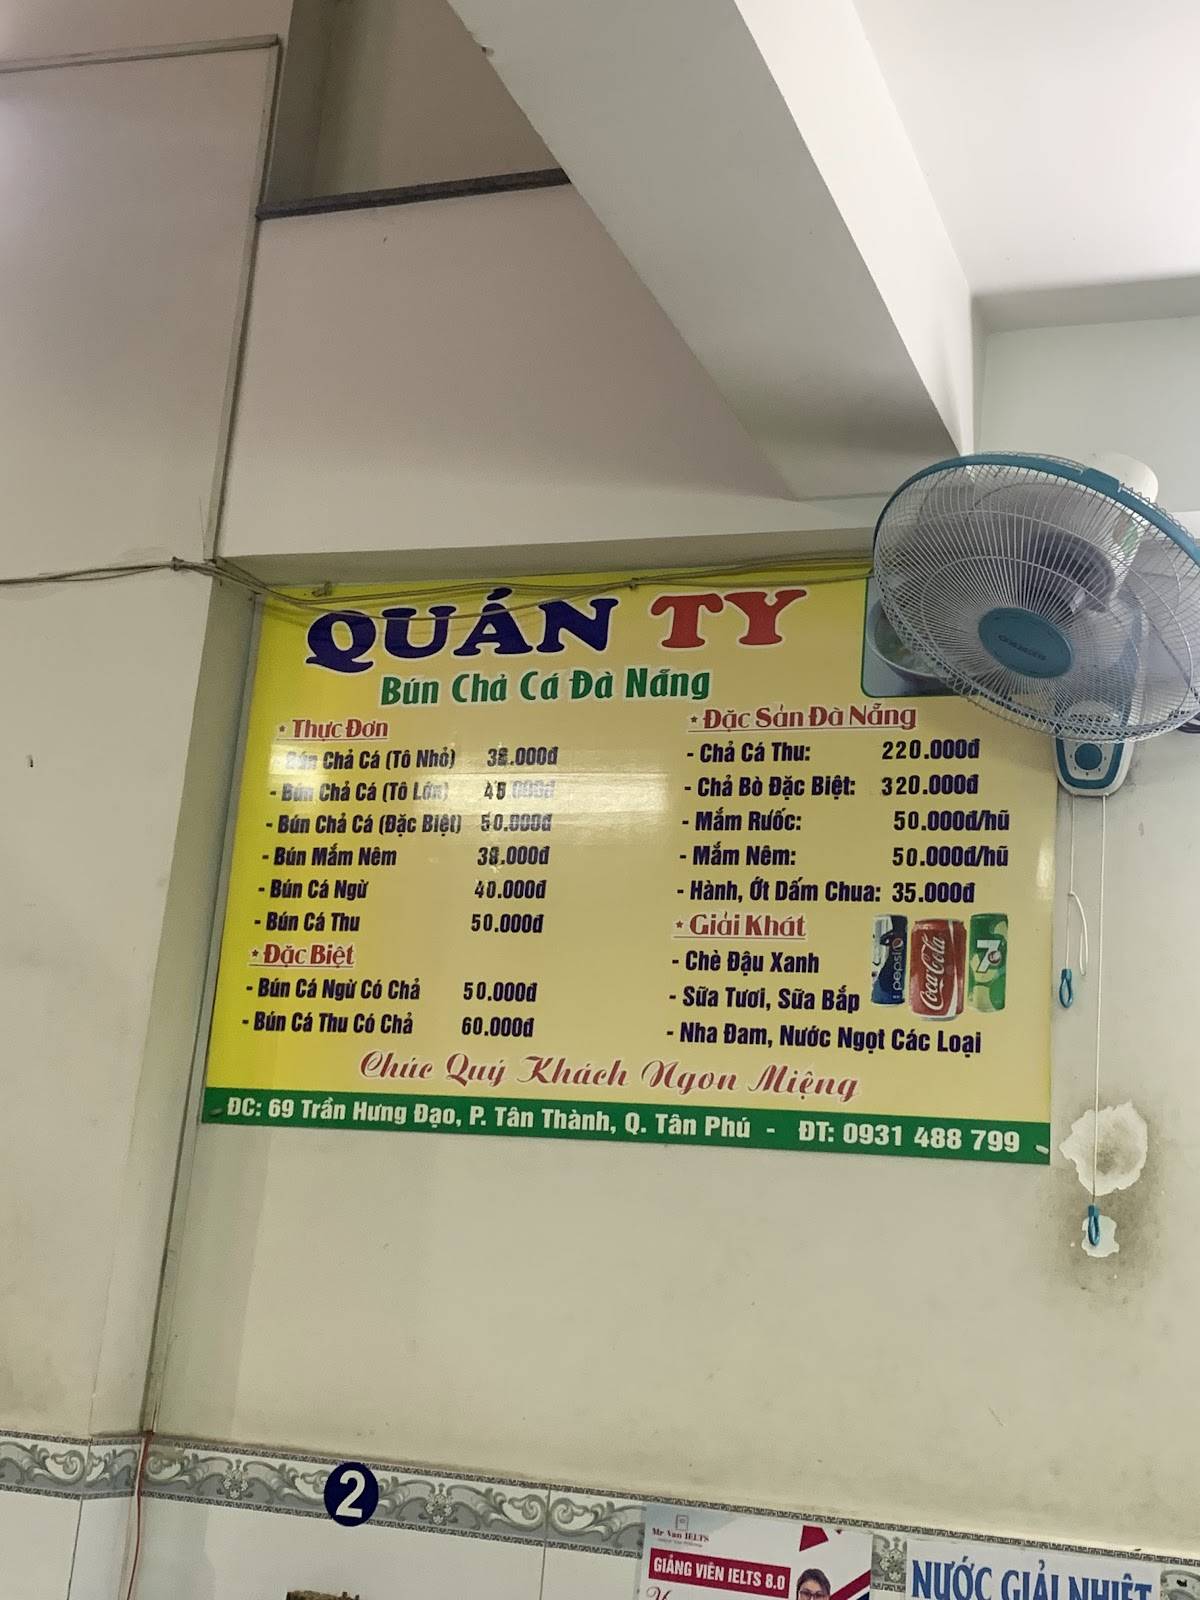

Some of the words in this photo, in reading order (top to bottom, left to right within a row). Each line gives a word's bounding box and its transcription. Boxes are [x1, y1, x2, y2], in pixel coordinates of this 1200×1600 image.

[306, 587, 619, 673] QUÁN
[651, 588, 807, 648] TY
[381, 677, 439, 705] Bún
[452, 673, 507, 702] Chả
[520, 672, 559, 700] Cá
[569, 671, 613, 700] Đà
[703, 709, 750, 732] Đặc
[755, 704, 803, 728] Sản
[808, 706, 843, 727] Đà
[849, 703, 916, 729] Nẵng
[293, 720, 343, 741] Thực
[345, 719, 388, 738] Đơn
[323, 749, 354, 769] Chả
[359, 751, 380, 769] Cá
[386, 749, 411, 770] (Tô
[416, 747, 455, 769] Nhỏ)
[699, 740, 735, 763] Chả
[740, 740, 766, 762] Cá
[771, 742, 811, 762] Thu:
[881, 738, 980, 760] 220.000đ
[282, 783, 313, 801] Bún
[319, 781, 350, 801] Chả
[356, 782, 376, 800] Cá
[383, 782, 407, 802] (Tô
[697, 775, 733, 797] Chả
[739, 775, 763, 796] Bò
[768, 776, 806, 799] Đặc
[810, 775, 856, 799] Biệt:
[880, 774, 979, 796] 320.000đ
[278, 815, 310, 833] Bún
[315, 812, 346, 833] Chả
[352, 814, 373, 833] Cá
[379, 815, 416, 836] (Đặc
[422, 814, 461, 836] Biệt)
[481, 813, 552, 831] 50.000đ
[695, 807, 743, 832] Mắm
[893, 808, 1010, 832] 50.000đ/hũ
[273, 847, 305, 866] Bún
[312, 843, 353, 866] Mắm
[358, 846, 397, 865] Nêm
[692, 842, 740, 866] Mắm
[745, 845, 797, 866] Nêm:
[891, 843, 1009, 867] 50.000đ/hũ
[270, 879, 302, 898] Bún
[308, 879, 329, 898] Cá
[334, 879, 369, 901] Ngừ
[475, 880, 547, 898] 40.000đ
[689, 880, 743, 904] Hành,
[749, 875, 771, 902] Ớt
[775, 876, 820, 902] Dấm
[825, 880, 881, 903] Chua:
[891, 881, 975, 903] 35.000đ
[266, 912, 298, 932] Bún
[304, 912, 325, 931] Cá
[331, 912, 361, 931] Thu
[471, 913, 544, 933] 50.000đ
[689, 912, 743, 936] Giải
[745, 914, 806, 937] Khát
[263, 944, 307, 968] Đặc
[310, 944, 355, 968] Biệt
[685, 950, 721, 972] Chè
[727, 951, 764, 977] Đậu
[770, 953, 819, 973] Xanh
[258, 978, 291, 999] Bún
[295, 978, 317, 999] Cá
[322, 979, 357, 1001] Ngừ
[361, 979, 384, 1000] Có
[389, 977, 420, 1000] Chả
[463, 981, 537, 1002] 50.000đ
[682, 986, 718, 1008] Sữa
[725, 988, 771, 1011] Tươi,
[778, 988, 816, 1010] Sữa
[821, 988, 860, 1014] Bắp
[253, 1012, 286, 1032] Bún
[290, 1012, 313, 1033] Cá
[318, 1013, 350, 1033] Thu
[353, 1013, 375, 1033] Có
[380, 1012, 413, 1035] Chả
[461, 1016, 534, 1038] 60.000đ
[680, 1023, 717, 1044] Nha
[723, 1023, 773, 1049] Đam,
[780, 1023, 830, 1049] Nước
[838, 1025, 884, 1056] Ngọt
[891, 1027, 930, 1052] Các
[937, 1031, 981, 1058] Loại
[360, 1051, 434, 1079] Chúc
[446, 1054, 505, 1087] Quý
[515, 1055, 627, 1087] Khách
[642, 1060, 737, 1096] Ngon
[748, 1063, 858, 1102] Miệng
[227, 1097, 262, 1118] ĐC:
[268, 1099, 294, 1118] 69
[301, 1096, 345, 1120] Trần
[352, 1103, 406, 1125] Hưng
[413, 1105, 461, 1129] Đạo,
[469, 1106, 488, 1127] P.
[495, 1106, 534, 1129] Tân
[541, 1108, 616, 1134] Thành,
[624, 1112, 646, 1134] Q.
[655, 1112, 697, 1136] Tân
[705, 1114, 750, 1139] Phú
[798, 1120, 834, 1143] ĐT:
[843, 1123, 903, 1147] 0931
[914, 1128, 961, 1150] 488
[970, 1129, 1020, 1152] 799
[336, 1469, 365, 1518] 2
[652, 1527, 663, 1536] Mr
[685, 1532, 709, 1542] IELTS
[654, 1554, 692, 1576] GIẢNG
[696, 1562, 724, 1580] VIÊN
[728, 1567, 761, 1587] IELTS
[765, 1573, 785, 1590] 8.0
[912, 1555, 992, 1600] NƯỚC
